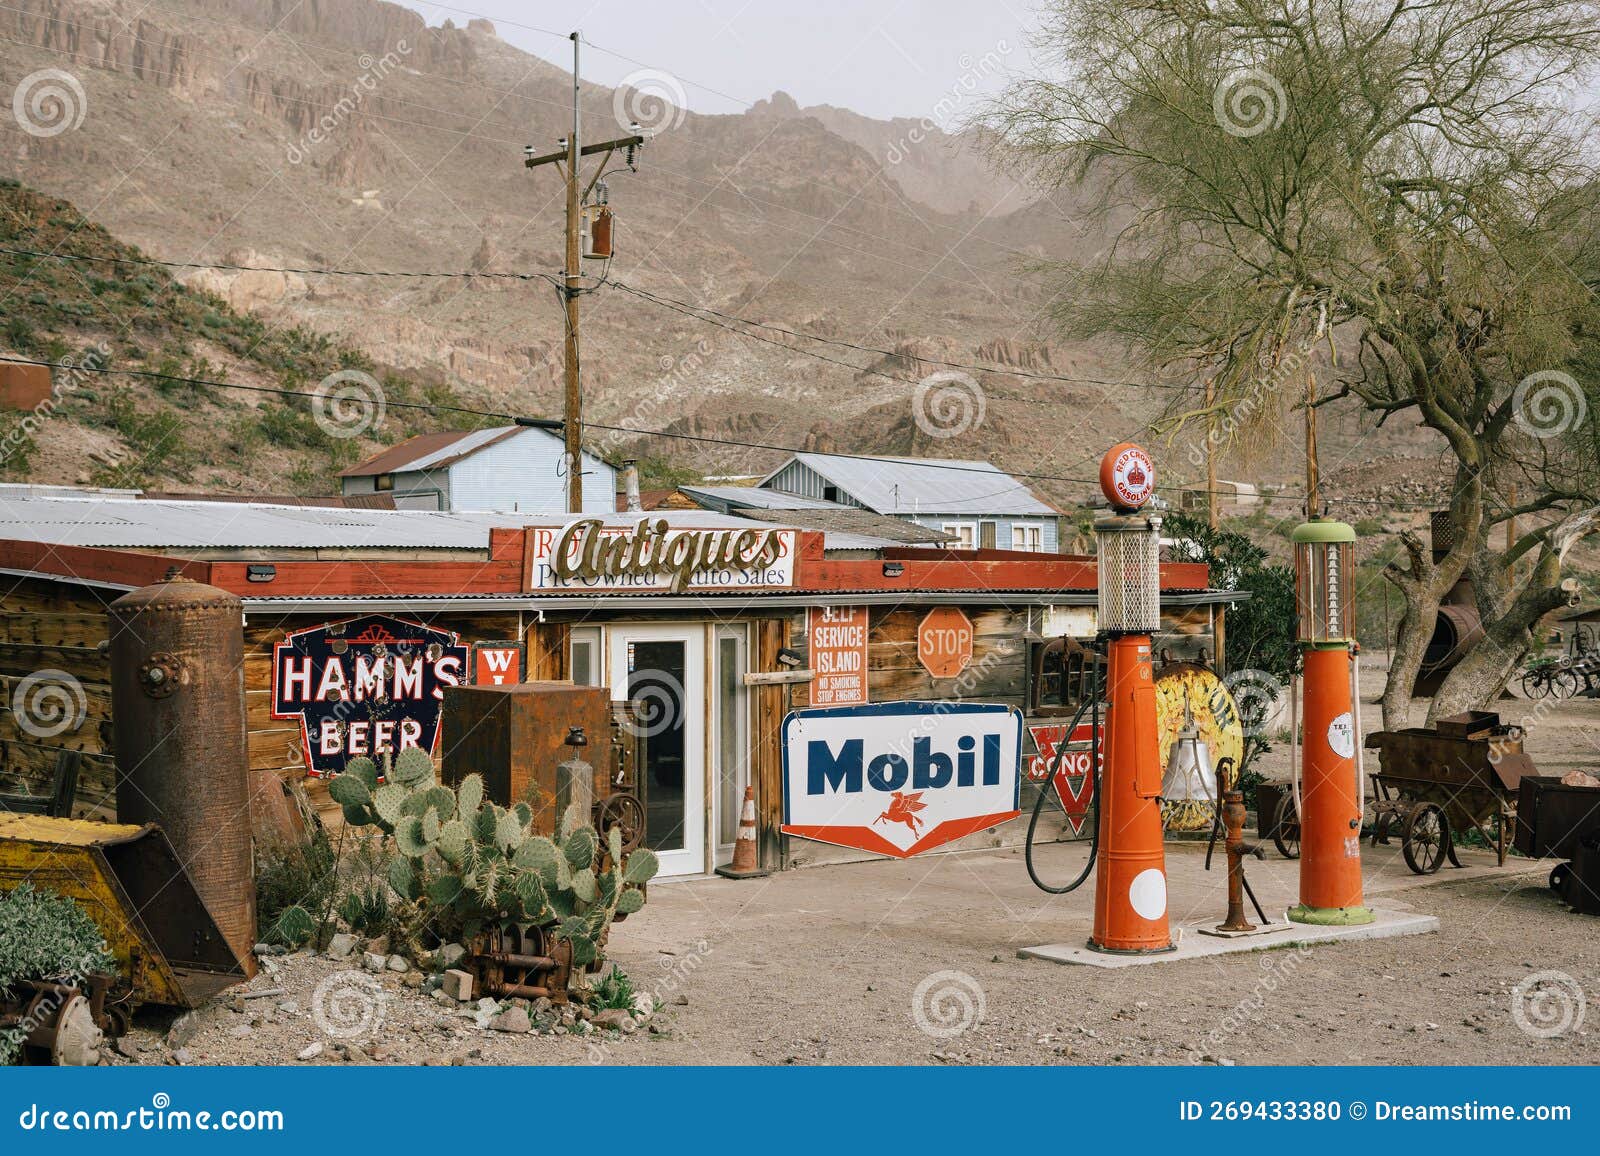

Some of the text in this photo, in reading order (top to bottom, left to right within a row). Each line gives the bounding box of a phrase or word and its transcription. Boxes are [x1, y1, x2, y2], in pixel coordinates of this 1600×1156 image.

[1116, 453, 1129, 473] RED
[1117, 482, 1152, 501] GASOLINE
[549, 518, 781, 593] Antiques
[815, 626, 863, 648] SERVICE
[923, 629, 969, 656] STOP
[817, 651, 860, 673] ISLAND
[283, 650, 461, 701] HAMM'S
[819, 677, 828, 690] NO
[817, 690, 833, 702] STOP
[320, 721, 422, 756] BEER
[807, 733, 1001, 796] Mobil
